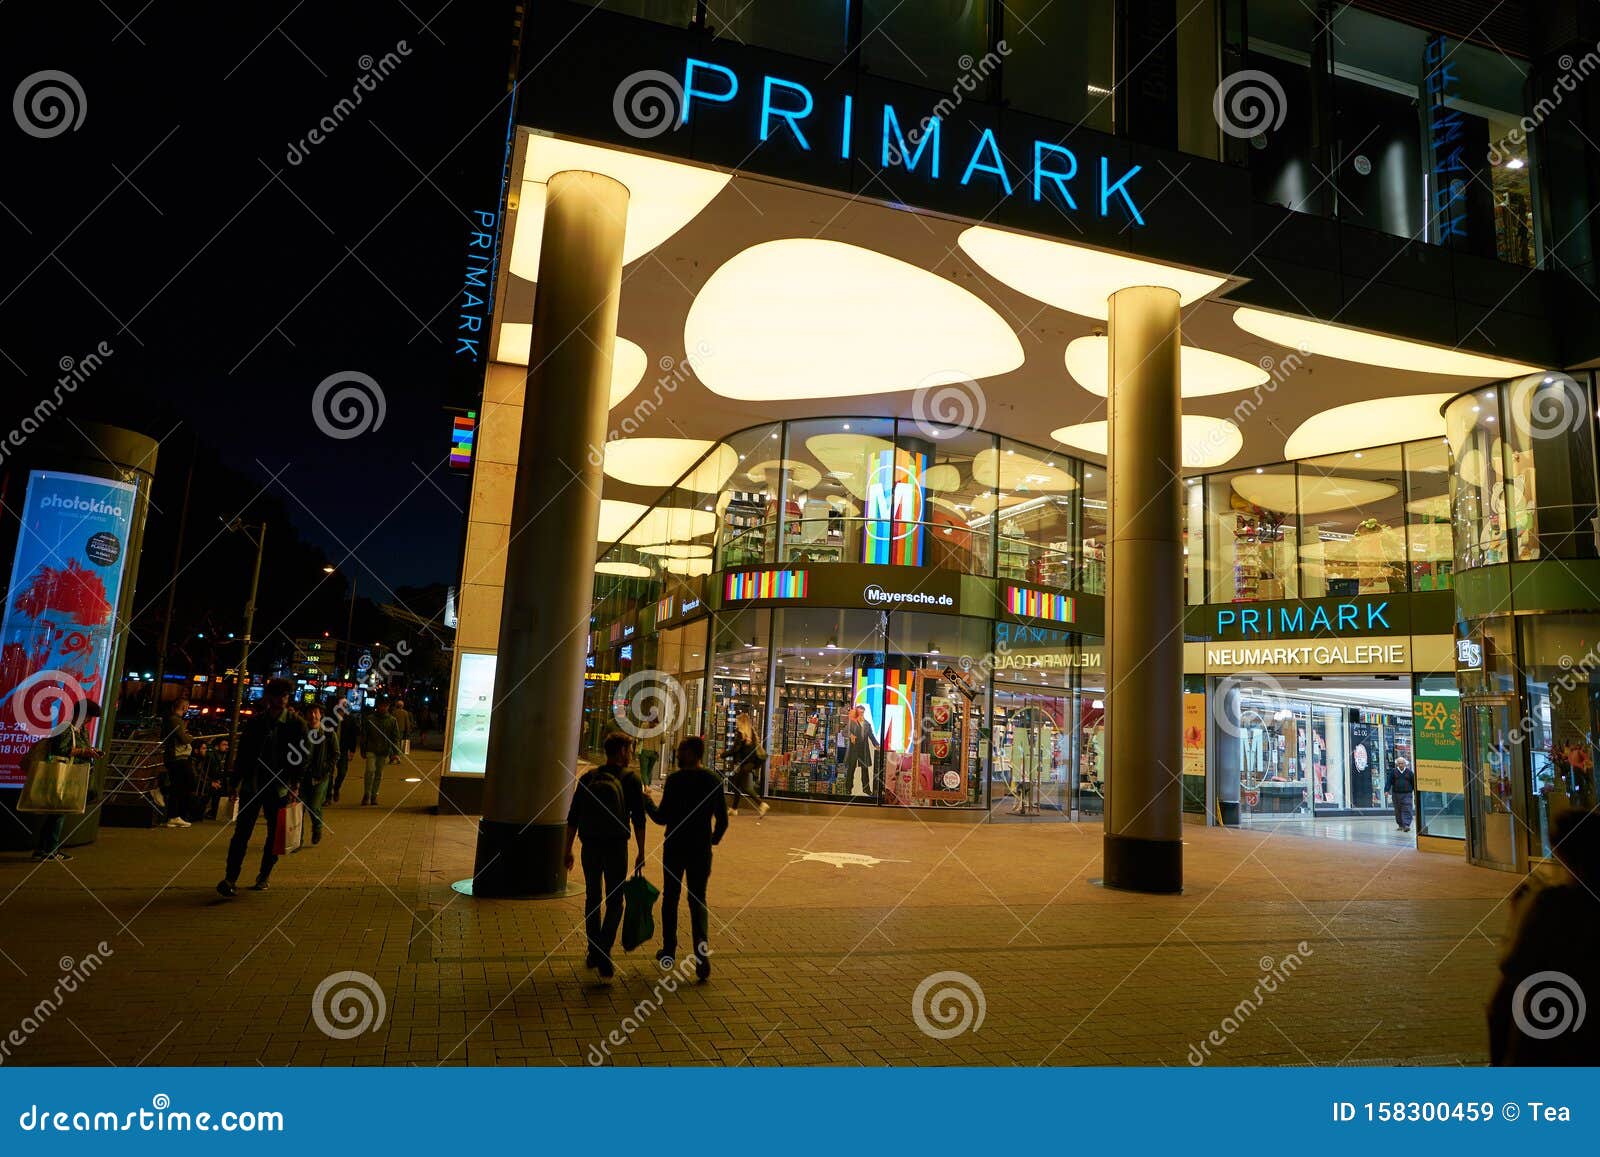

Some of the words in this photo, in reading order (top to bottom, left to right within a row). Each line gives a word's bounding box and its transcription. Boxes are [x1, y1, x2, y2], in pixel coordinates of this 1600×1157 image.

[681, 57, 1146, 226] PRIMARK
[455, 210, 495, 355] PRIMARK
[41, 494, 122, 517] photokina
[866, 588, 953, 605] Mayersche.de
[1217, 602, 1390, 634] PRIMARK
[1208, 645, 1404, 666] NEUMARKTGALERIE
